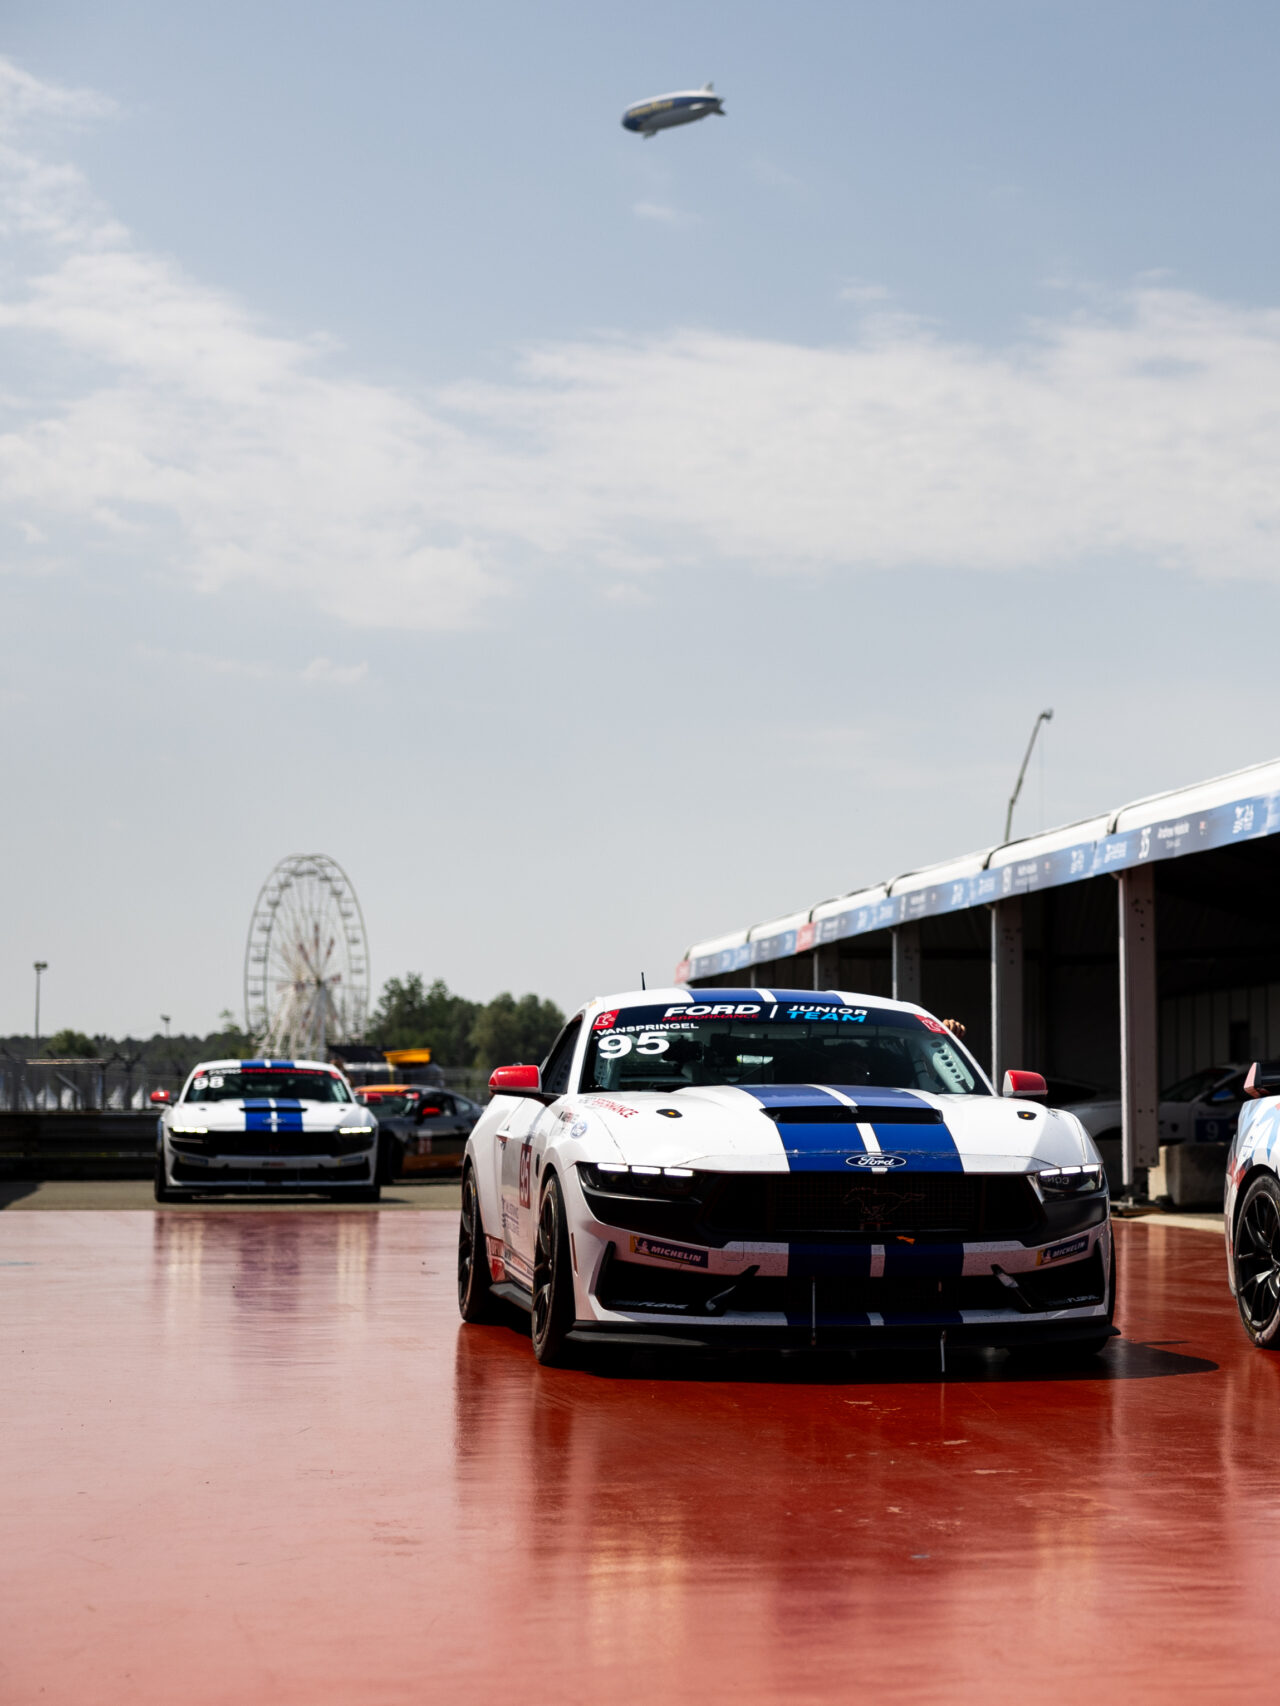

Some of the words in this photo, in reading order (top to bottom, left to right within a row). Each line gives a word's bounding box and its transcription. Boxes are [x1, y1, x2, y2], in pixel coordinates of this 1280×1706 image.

[663, 1004, 761, 1017] FORD
[786, 1010, 866, 1023] TEAM
[788, 1004, 868, 1016] JUNIOR
[661, 1013, 760, 1022] PERFORMANCE
[596, 1022, 700, 1036] VANSPRINGEL
[598, 1031, 670, 1059] 95
[193, 1075, 225, 1091] 98
[857, 1155, 895, 1167] Ford
[650, 1245, 702, 1262] MICHELIN
[1051, 1239, 1087, 1258] MICHELIN
